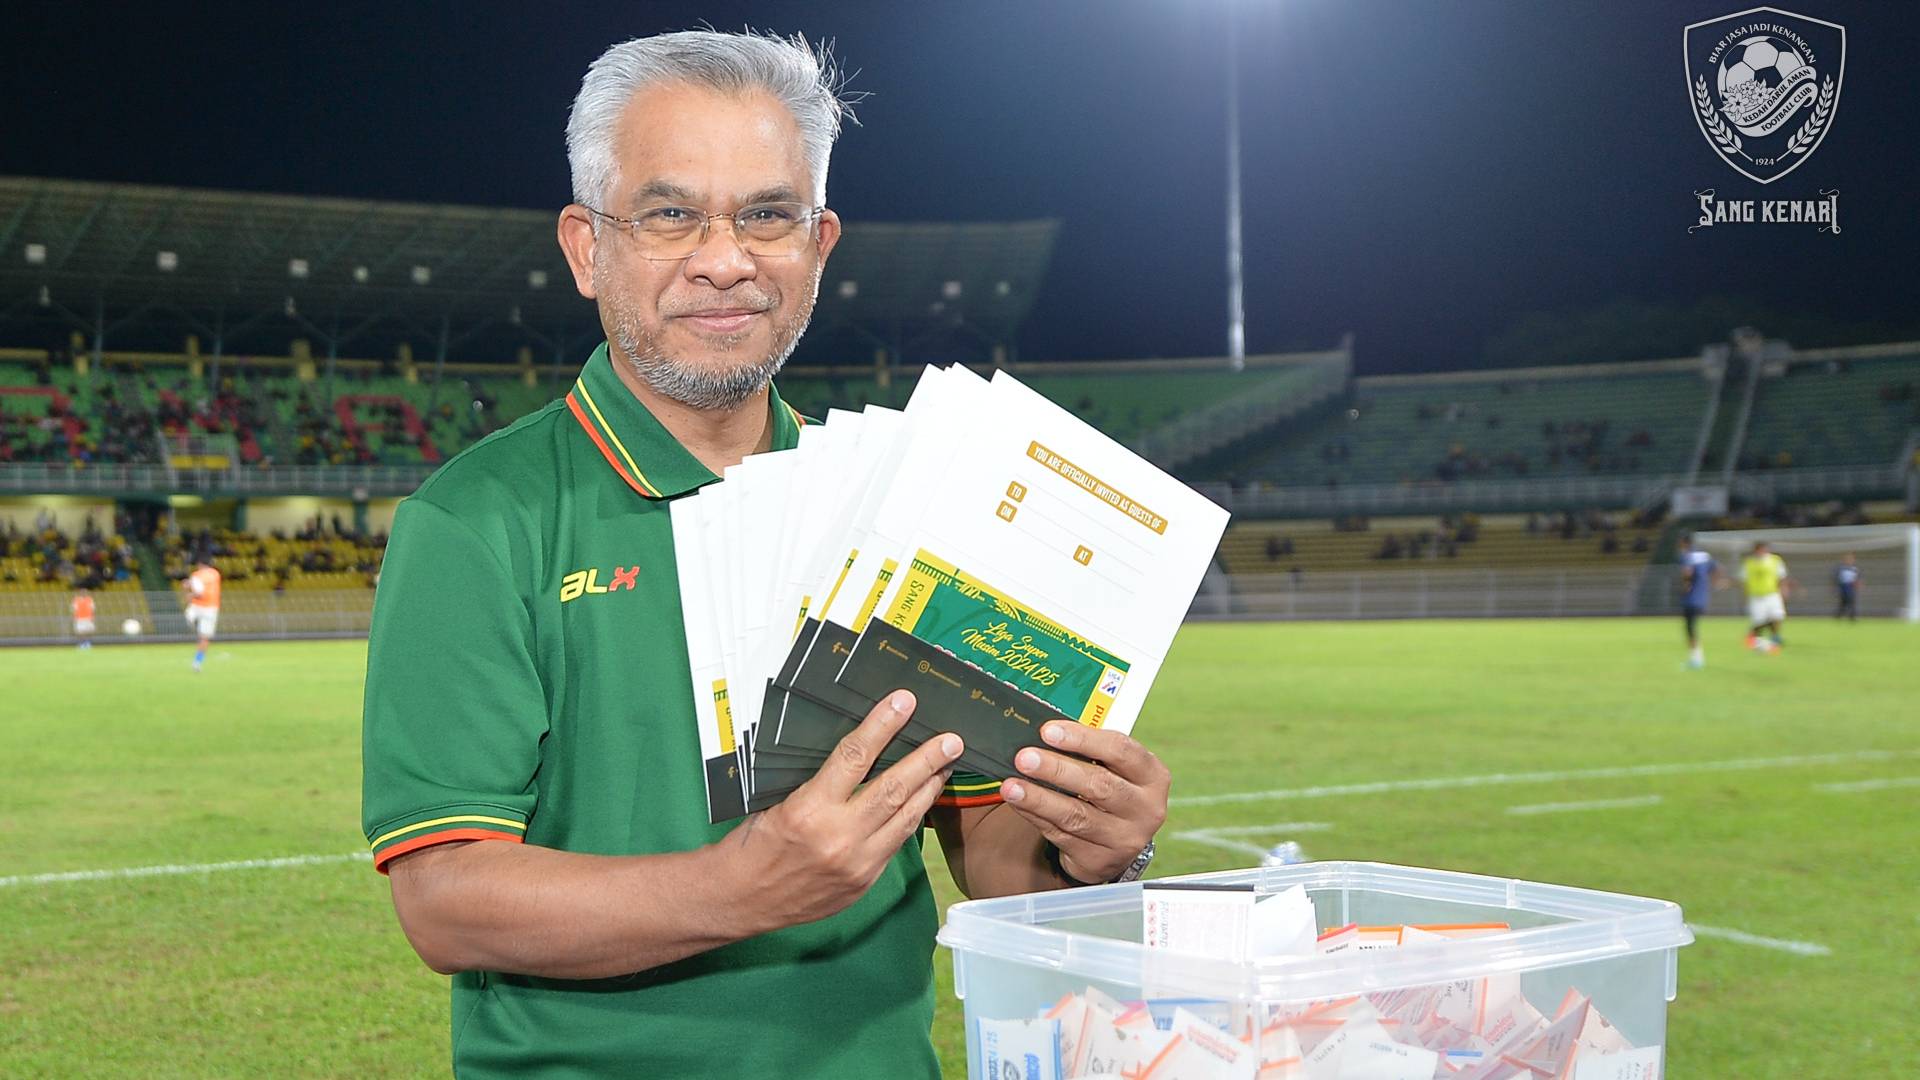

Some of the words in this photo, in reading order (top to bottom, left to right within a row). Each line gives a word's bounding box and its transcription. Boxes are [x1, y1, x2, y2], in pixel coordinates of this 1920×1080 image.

[1012, 485, 1022, 499] TO
[1034, 447, 1048, 462] YOU
[1047, 456, 1061, 470] ARE
[1060, 464, 1097, 490] OFFICIALLY
[1096, 483, 1121, 505] INVITED
[1119, 497, 1130, 510] AS
[1129, 504, 1152, 524] GUESTS
[1151, 518, 1162, 530] OF
[1078, 549, 1090, 562] AT
[900, 580, 925, 617] SANG
[961, 628, 1000, 658] Musim
[996, 650, 1060, 686] 2024/25
[984, 621, 1014, 643] Liga
[1012, 635, 1049, 662] Super
